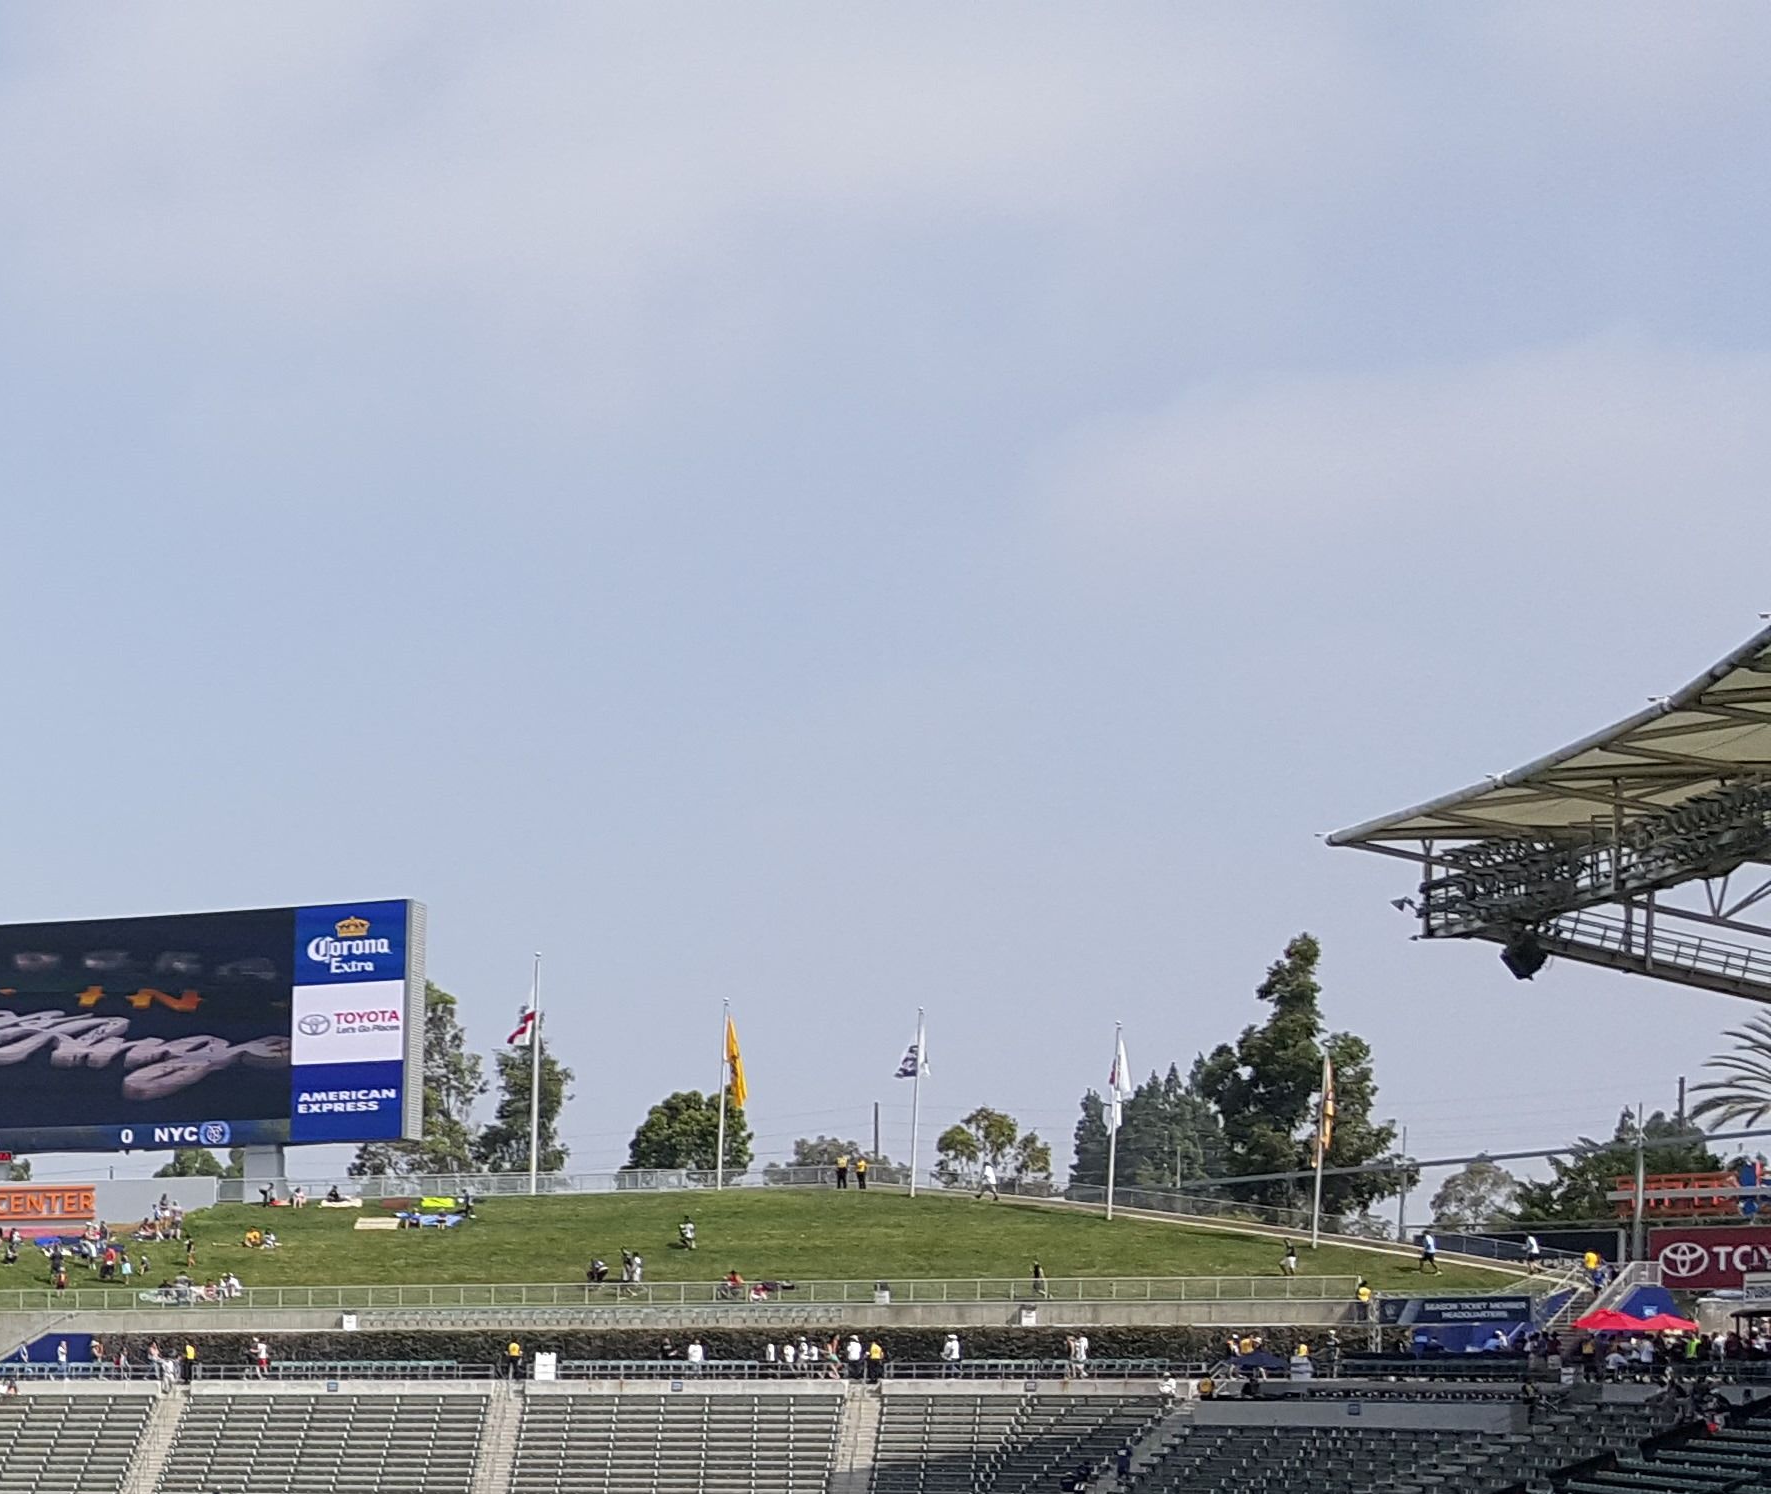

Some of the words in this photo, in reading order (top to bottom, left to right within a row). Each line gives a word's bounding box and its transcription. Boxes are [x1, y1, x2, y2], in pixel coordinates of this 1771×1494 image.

[307, 936, 392, 963] Corona
[330, 958, 374, 974] Extra
[334, 1010, 399, 1024] TOYOTA
[299, 1088, 396, 1102] AMERICAN
[297, 1101, 379, 1113] EXPRESS
[121, 1129, 134, 1144] 0
[154, 1127, 198, 1142] NYC
